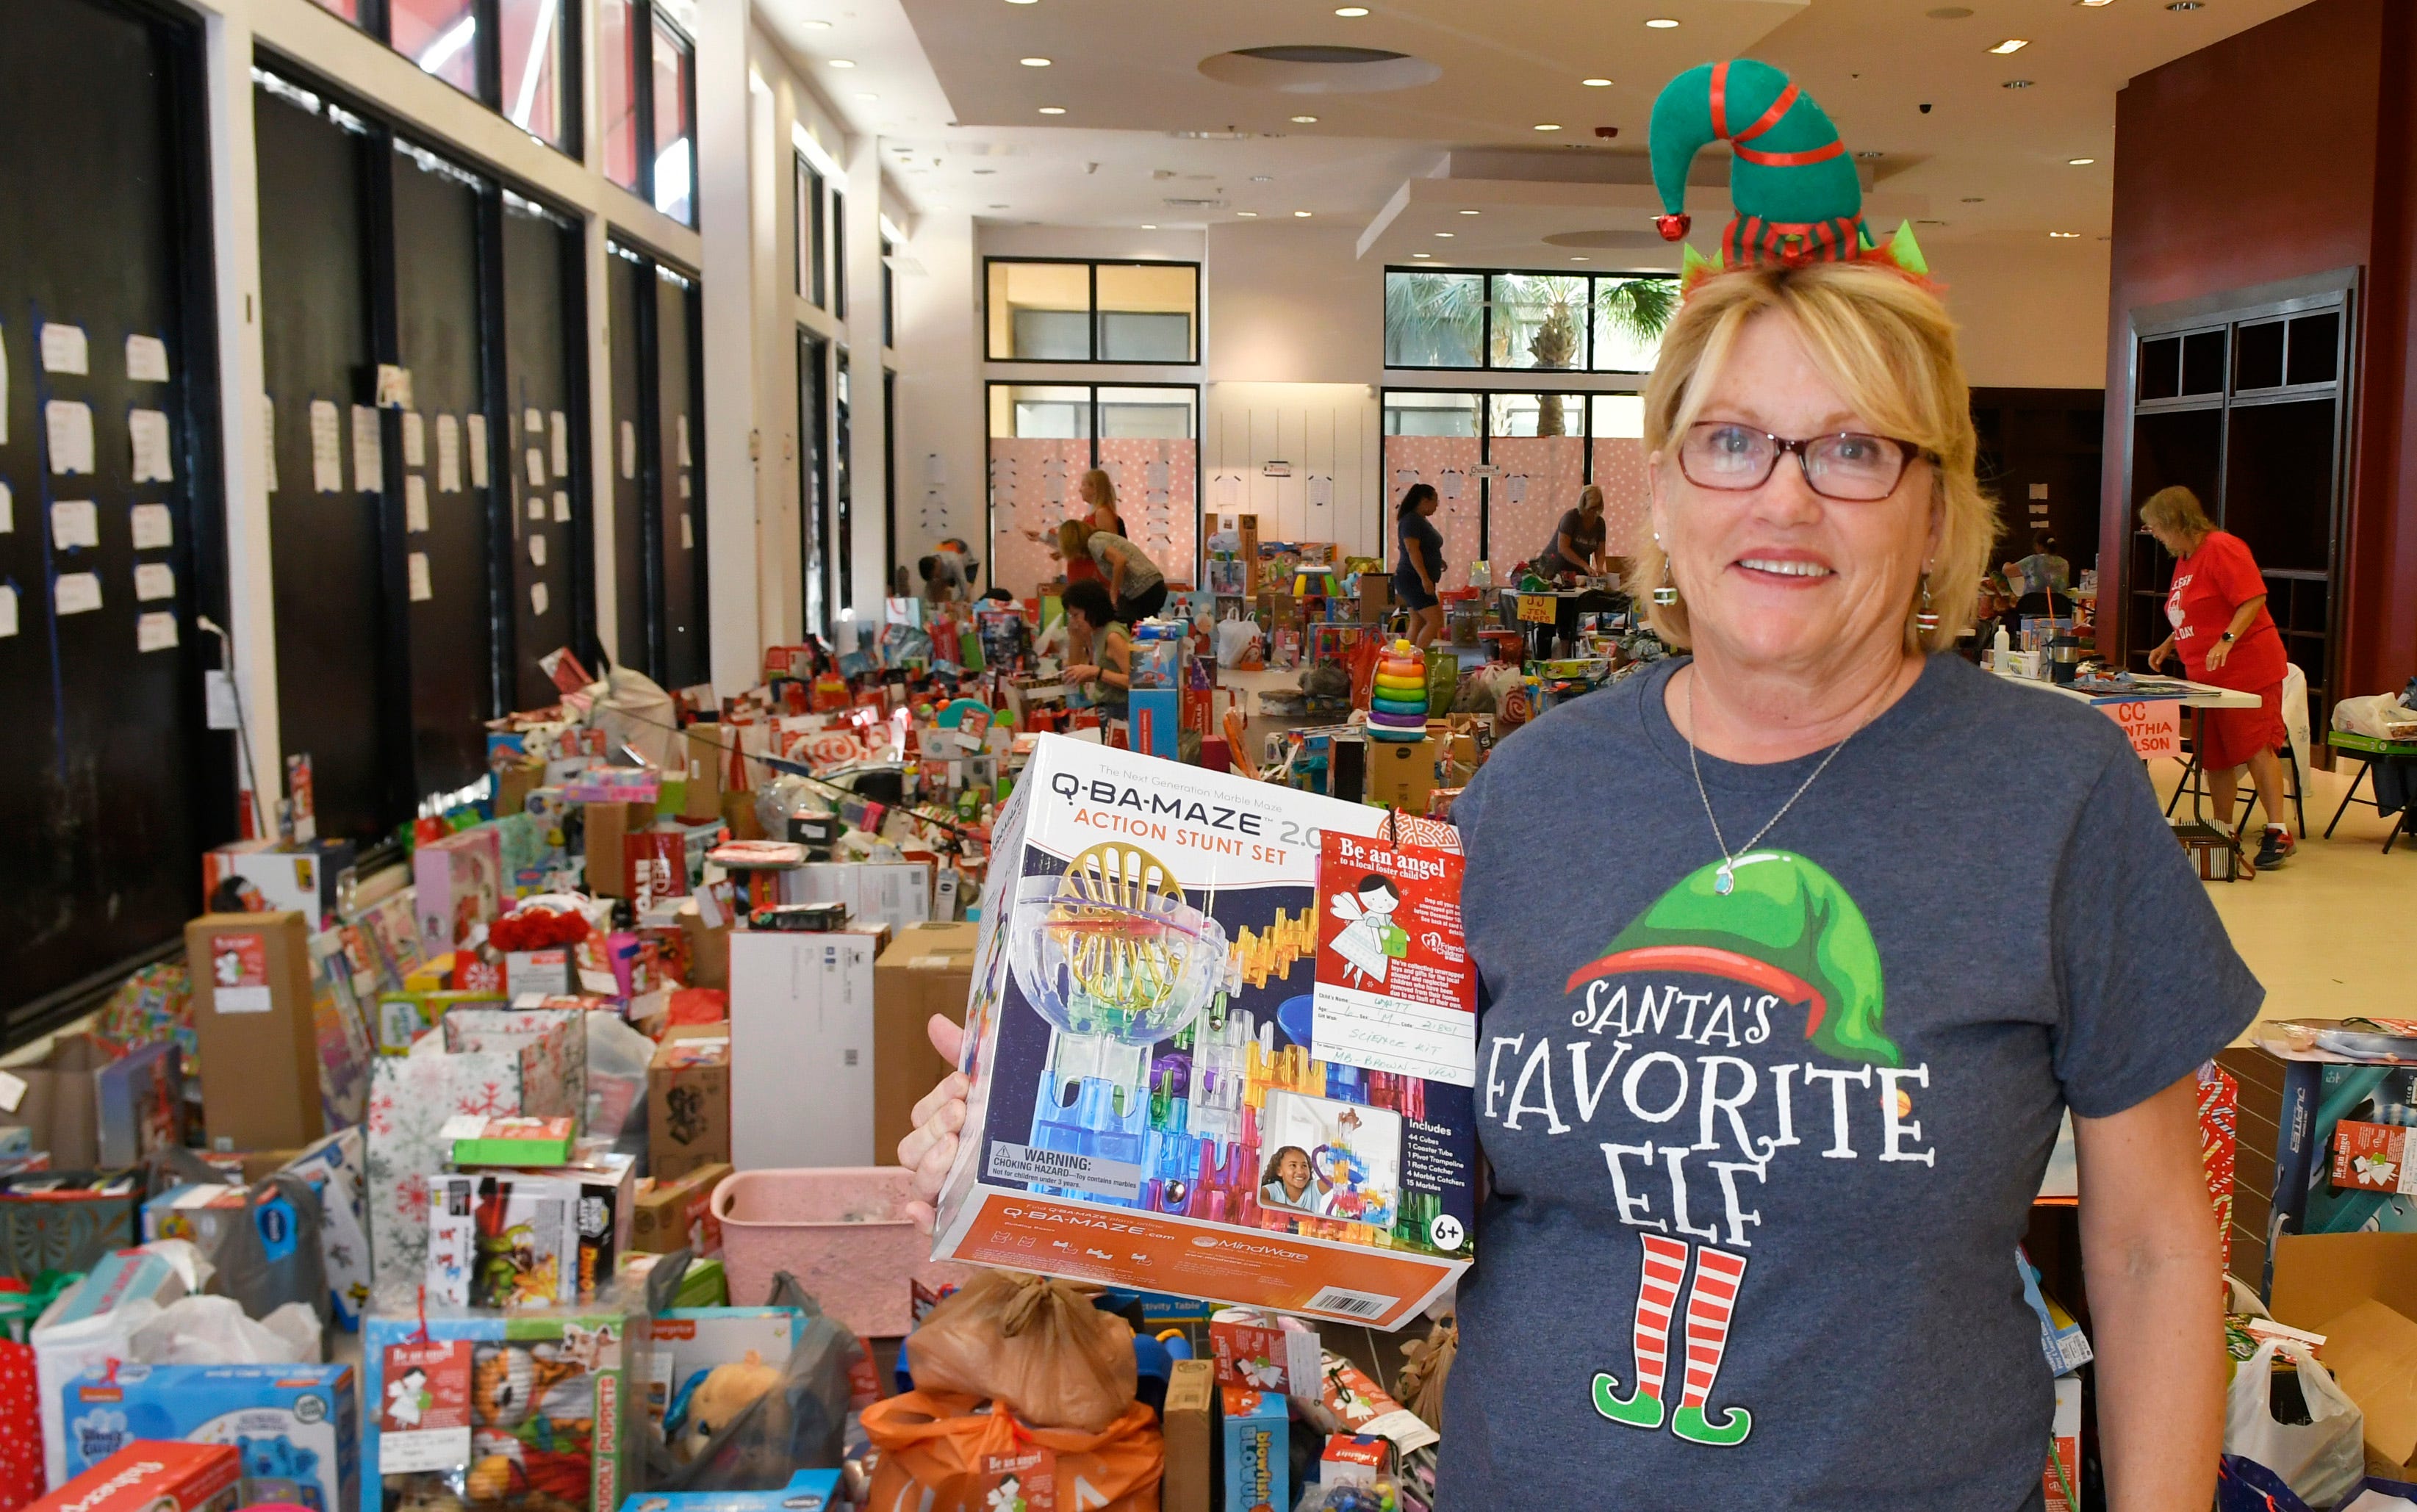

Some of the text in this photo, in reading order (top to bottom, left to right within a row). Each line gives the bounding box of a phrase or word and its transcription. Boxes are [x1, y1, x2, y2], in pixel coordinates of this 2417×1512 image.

[2119, 701, 2146, 722] CC
[2122, 721, 2172, 737] NTHIA
[2133, 738, 2170, 752] LSON
[1099, 764, 1283, 813] The Next Generation Marble Maze
[1074, 808, 1287, 865] ACTION STUNT SET
[1340, 837, 1445, 880] Be an angel
[1340, 857, 1348, 865] to
[1356, 860, 1374, 871] local
[1376, 863, 1398, 875] foster
[1399, 869, 1419, 880] child
[1430, 911, 1454, 921] December
[1437, 947, 1464, 959] Children
[1440, 942, 1465, 954] Friends
[1391, 958, 1465, 979] We're collecting unwrapped
[1391, 965, 1402, 973] toys
[1415, 970, 1427, 978] gifts
[1390, 971, 1411, 980] abused
[1423, 978, 1449, 988] neglected
[1390, 977, 1412, 987] children
[1426, 984, 1439, 992] have
[1440, 987, 1454, 996] been
[1390, 984, 1414, 993] removed
[1415, 988, 1428, 996] from
[1442, 994, 1460, 1003] homes
[1416, 995, 1429, 1003] fault
[1571, 978, 1779, 1048] SANTA'S
[1484, 1032, 1936, 1167] FAVORITE
[1409, 1118, 1452, 1137] Includes
[2290, 1087, 2306, 1154] JUPITER
[1412, 1143, 1437, 1153] Coaster
[1438, 1148, 1454, 1157] Tube
[1419, 1136, 1440, 1145] Cubes
[2338, 1133, 2350, 1155] angel
[1024, 1148, 1092, 1171] WARNING:
[1412, 1152, 1429, 1161] Pivot
[1429, 1155, 1465, 1169] Trampoline
[1412, 1162, 1428, 1170] Roto
[1429, 1165, 1454, 1176] Catcher
[2337, 1156, 2344, 1166] an
[994, 1157, 1032, 1171] CHOKING
[1087, 1176, 1112, 1185] contains
[1113, 1179, 1137, 1189] marbles
[1014, 1172, 1038, 1181] children
[1039, 1176, 1057, 1184] under
[1063, 1180, 1081, 1189] years.
[1413, 1171, 1436, 1181] Marble
[1437, 1176, 1465, 1187] Catchers
[2332, 1167, 2341, 1178] Be
[1415, 1181, 1442, 1192] Marbles
[1599, 1140, 1767, 1247] ELF
[1026, 1203, 1047, 1212] Find
[1109, 1217, 1134, 1225] plans
[1435, 1221, 1459, 1239] 6+
[1218, 1239, 1310, 1261] MindWare
[1141, 1302, 1171, 1312] ctivity
[597, 1377, 616, 1452] PUPPETS
[1256, 1431, 1272, 1501] blowfish
